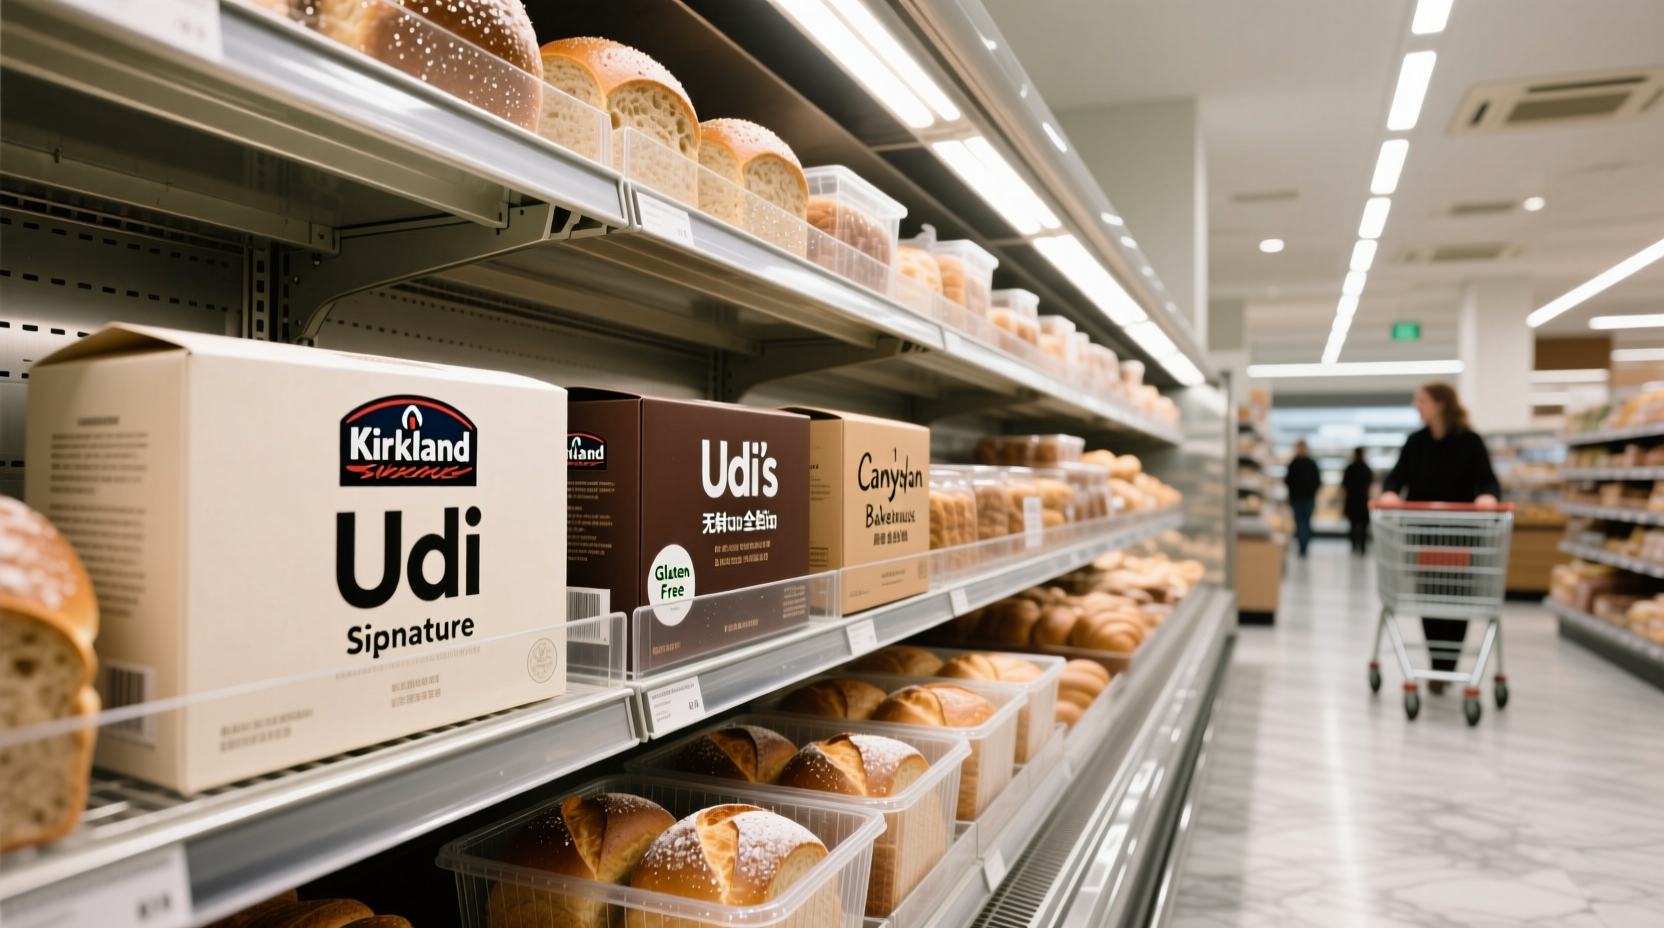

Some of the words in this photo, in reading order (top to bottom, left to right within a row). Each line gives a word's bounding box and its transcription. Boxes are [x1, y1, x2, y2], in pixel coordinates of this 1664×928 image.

[350, 426, 470, 462] Kirkland
[702, 439, 779, 498] Udi's
[336, 505, 482, 609] Udi
[661, 583, 685, 600] Free
[346, 617, 475, 659] Sipnature
